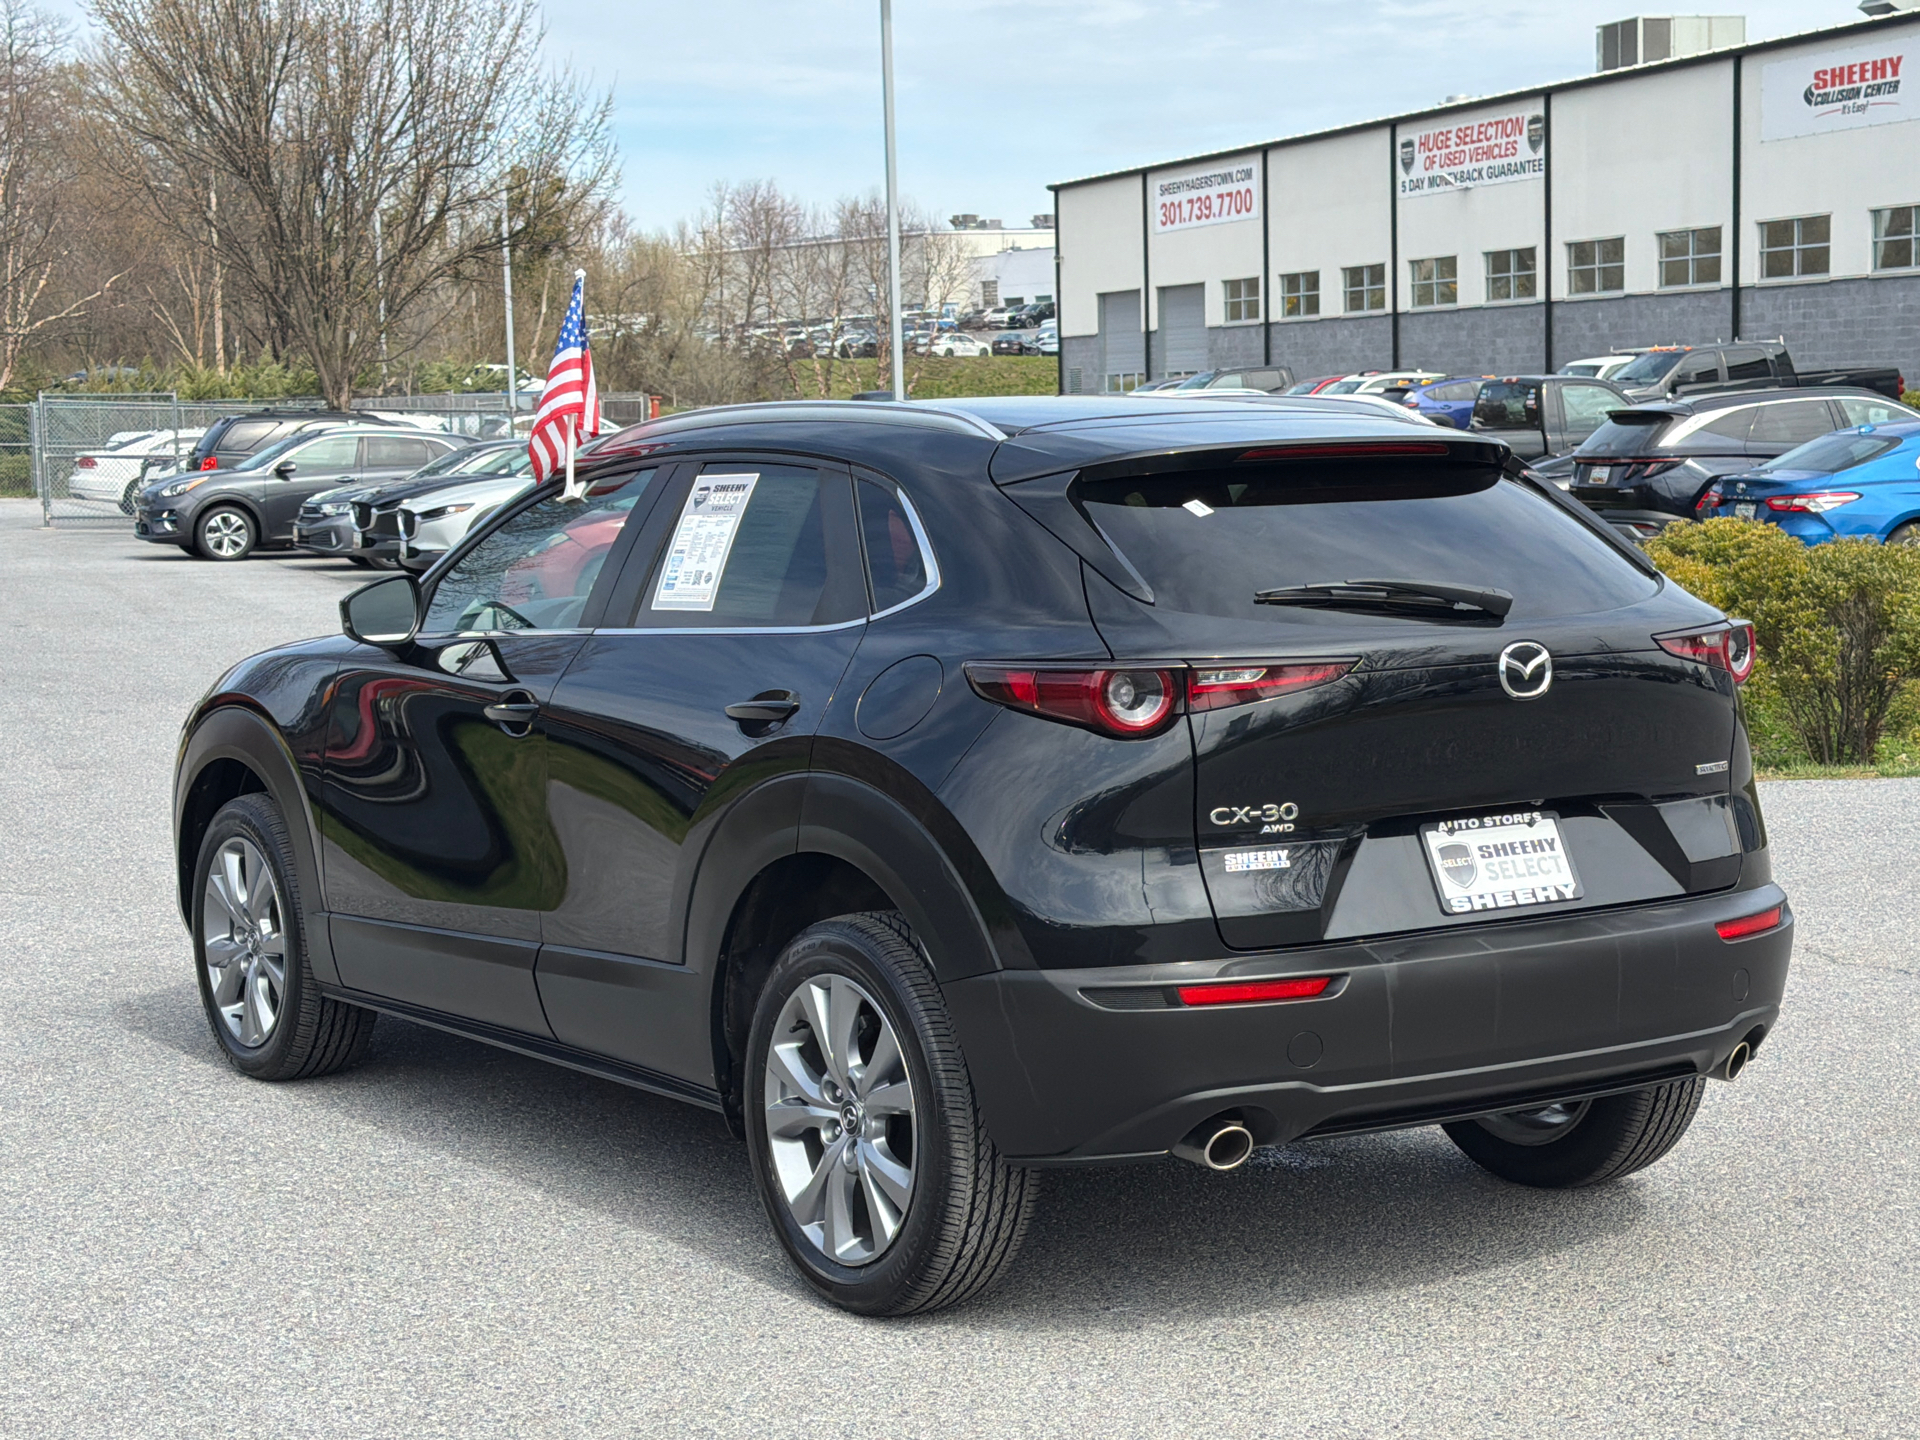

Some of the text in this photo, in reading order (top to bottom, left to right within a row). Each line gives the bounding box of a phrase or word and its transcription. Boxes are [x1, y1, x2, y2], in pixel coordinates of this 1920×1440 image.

[1814, 55, 1903, 91] SHEEHY
[1814, 79, 1900, 107] COLLISION CENTER
[1418, 129, 1452, 154] HUGE
[1454, 115, 1525, 147] SELECTION
[1423, 154, 1437, 171] OF
[1439, 149, 1466, 169] USED
[1469, 140, 1519, 163] VEHICLES
[1159, 167, 1253, 197] SHEEHYHAGERSTOWN.COM
[1401, 180, 1407, 193] 5
[1409, 177, 1425, 192] DAY
[1486, 158, 1543, 179] GUARANTEE
[1160, 188, 1253, 226] 301.739.7700
[708, 493, 745, 505] SELECT
[713, 484, 748, 493] SHEEHY
[1209, 802, 1299, 826] CX-30
[1437, 811, 1543, 833] AUTO STORES
[1259, 823, 1295, 835] AWD
[1224, 850, 1289, 865] SHEEHY
[1477, 837, 1556, 859] SHEEHY
[1442, 856, 1472, 868] SELECT
[1484, 855, 1563, 881] SELECT
[1450, 883, 1576, 913] SHEEHY
